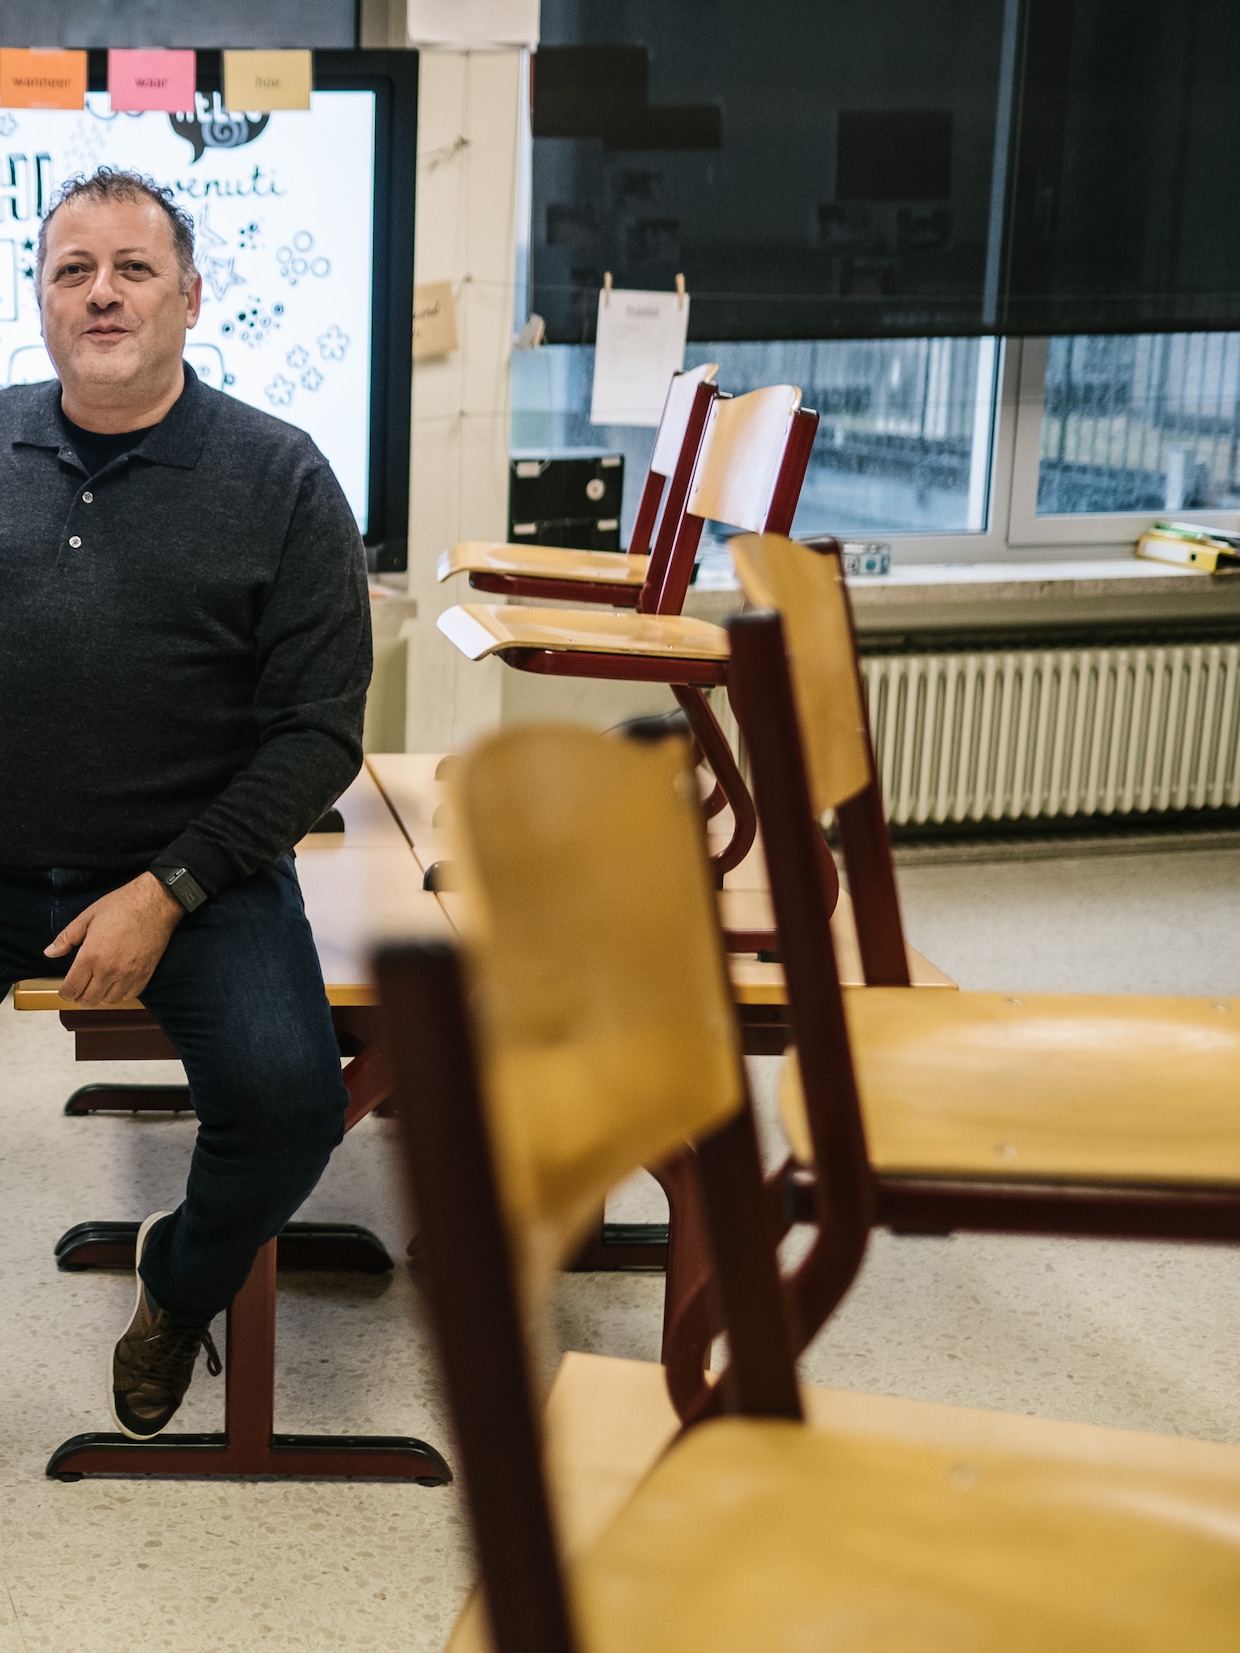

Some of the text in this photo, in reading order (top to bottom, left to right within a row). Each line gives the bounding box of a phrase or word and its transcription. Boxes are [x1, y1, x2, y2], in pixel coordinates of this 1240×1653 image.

[12, 76, 71, 90] wanneer
[135, 77, 167, 89] waar
[255, 76, 281, 88] hoe
